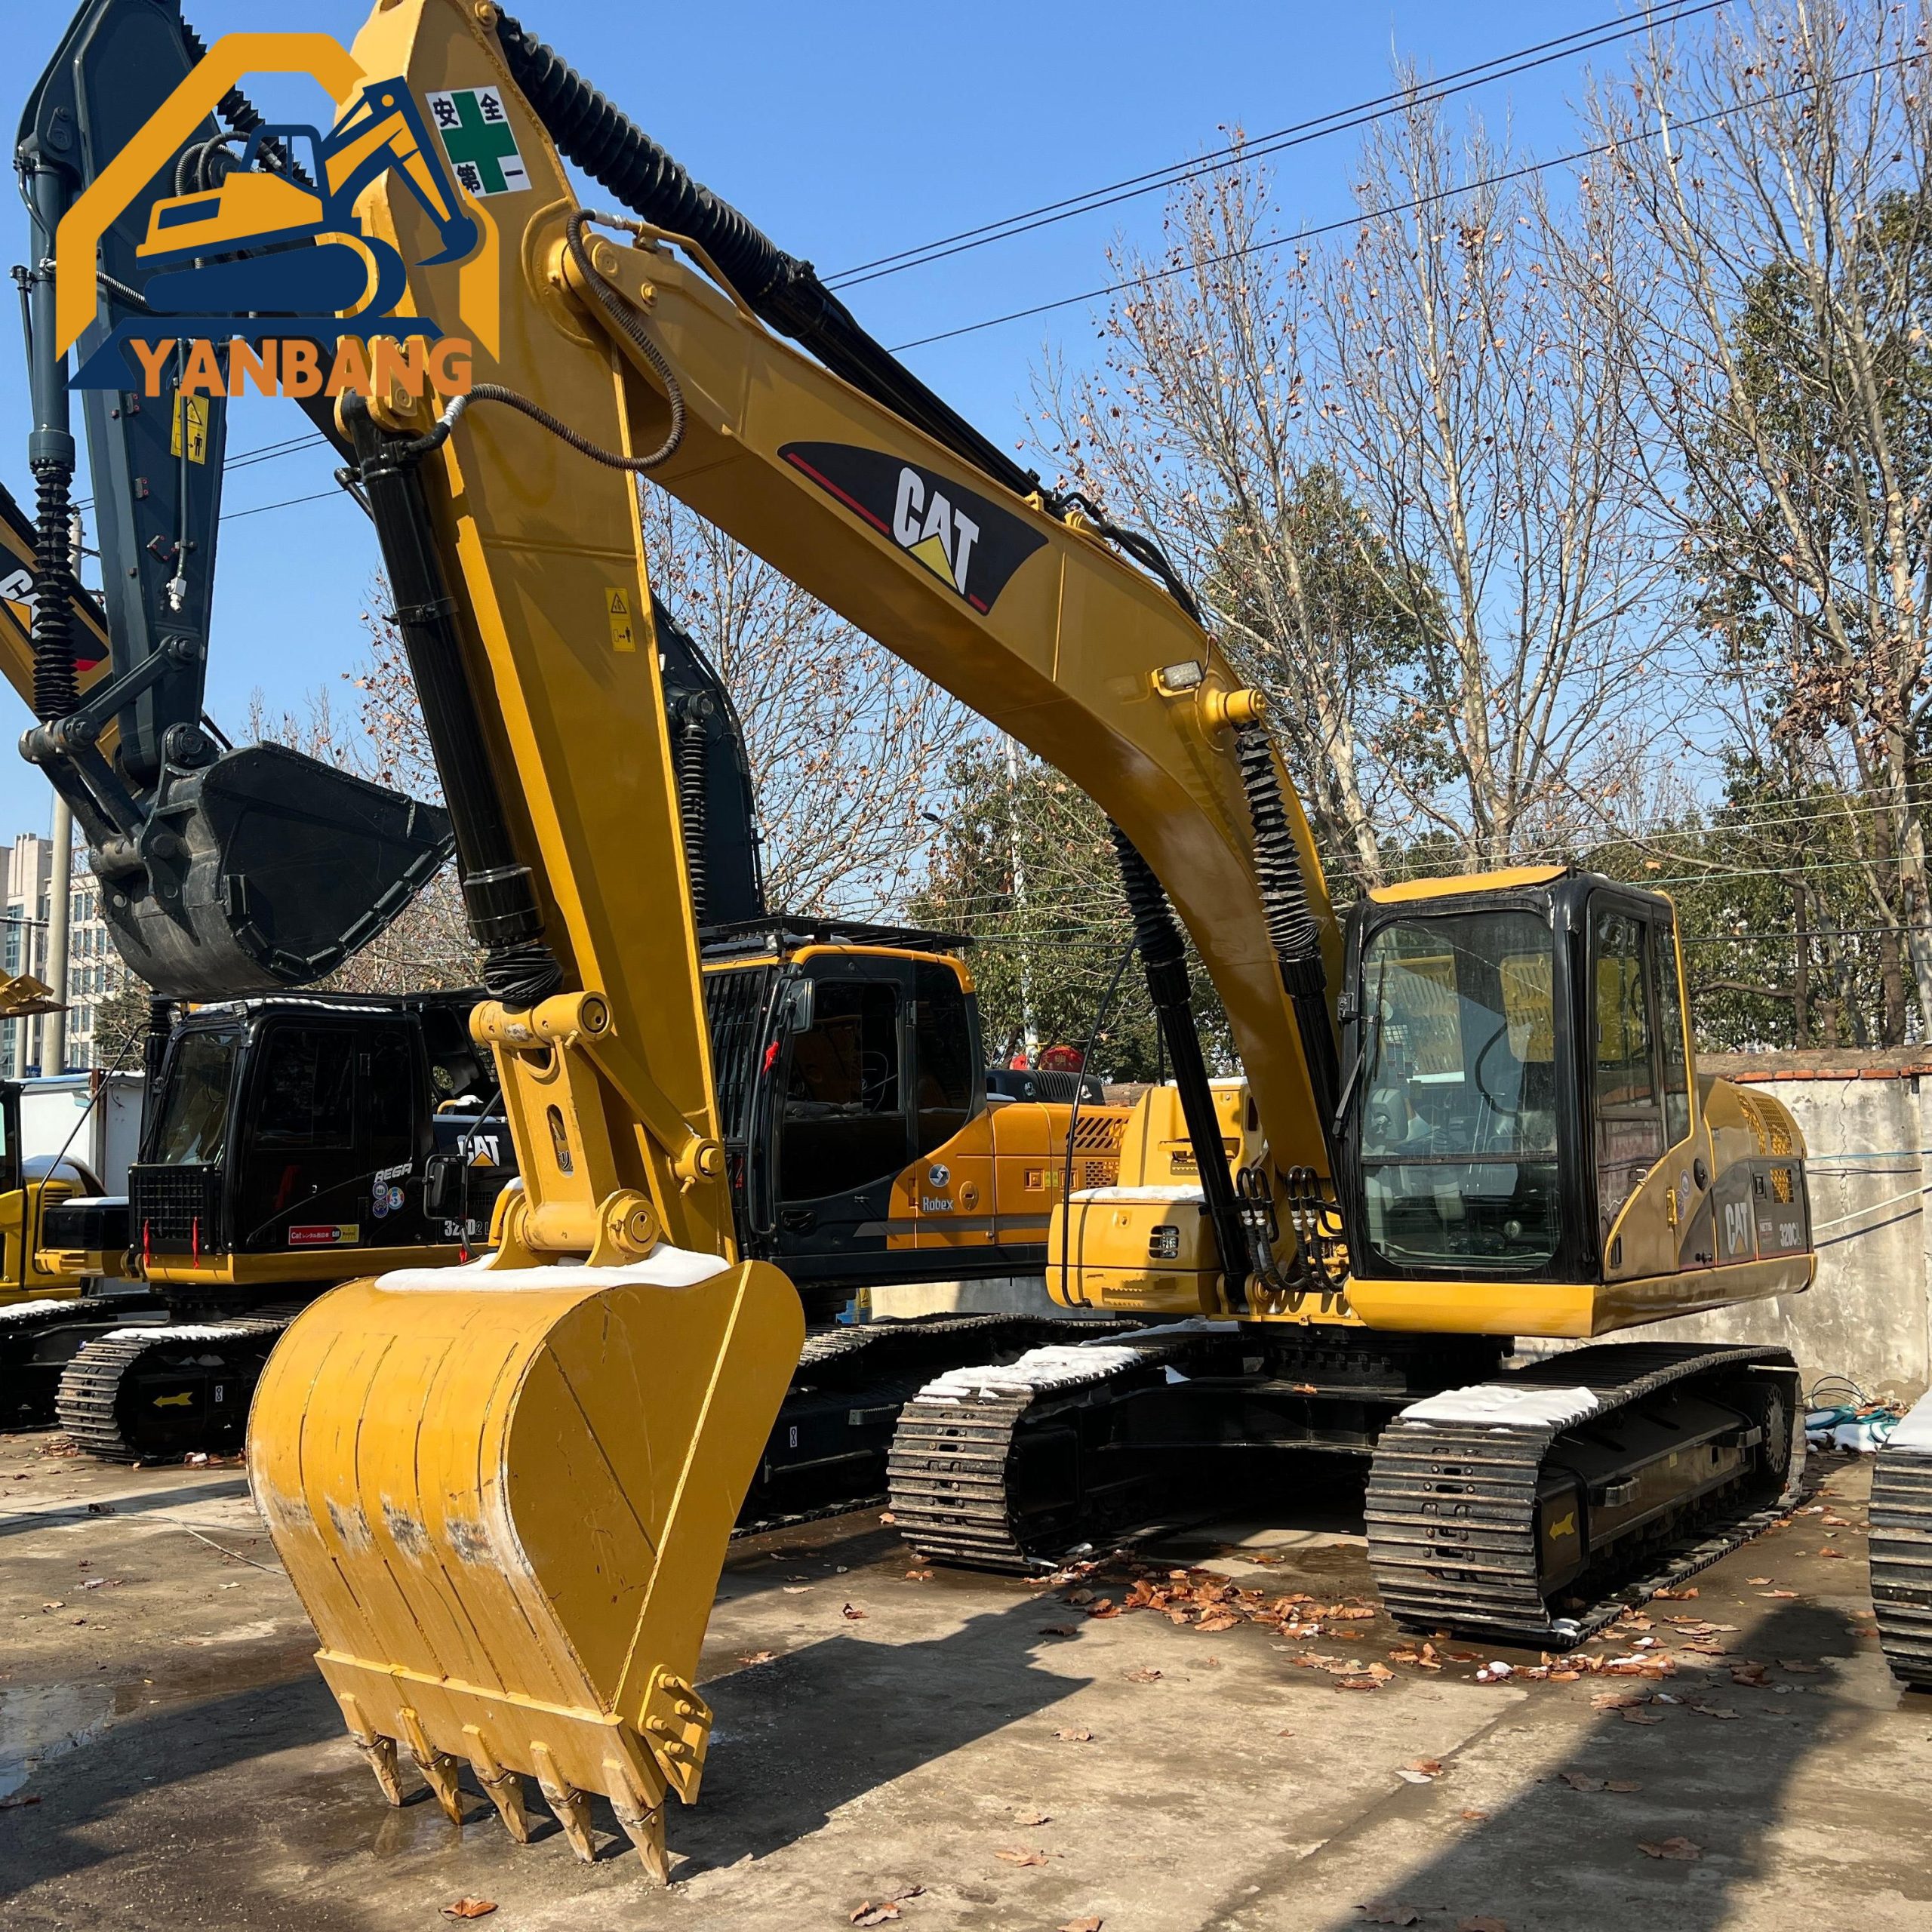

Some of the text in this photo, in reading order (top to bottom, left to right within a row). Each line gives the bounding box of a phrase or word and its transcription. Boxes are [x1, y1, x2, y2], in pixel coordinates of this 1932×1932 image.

[432, 93, 503, 128] 安全
[893, 466, 980, 595] CAT
[457, 1134, 500, 1167] CAT
[374, 1162, 413, 1183] REGA
[922, 1196, 954, 1211] Robex
[1724, 1201, 1749, 1254] CAT
